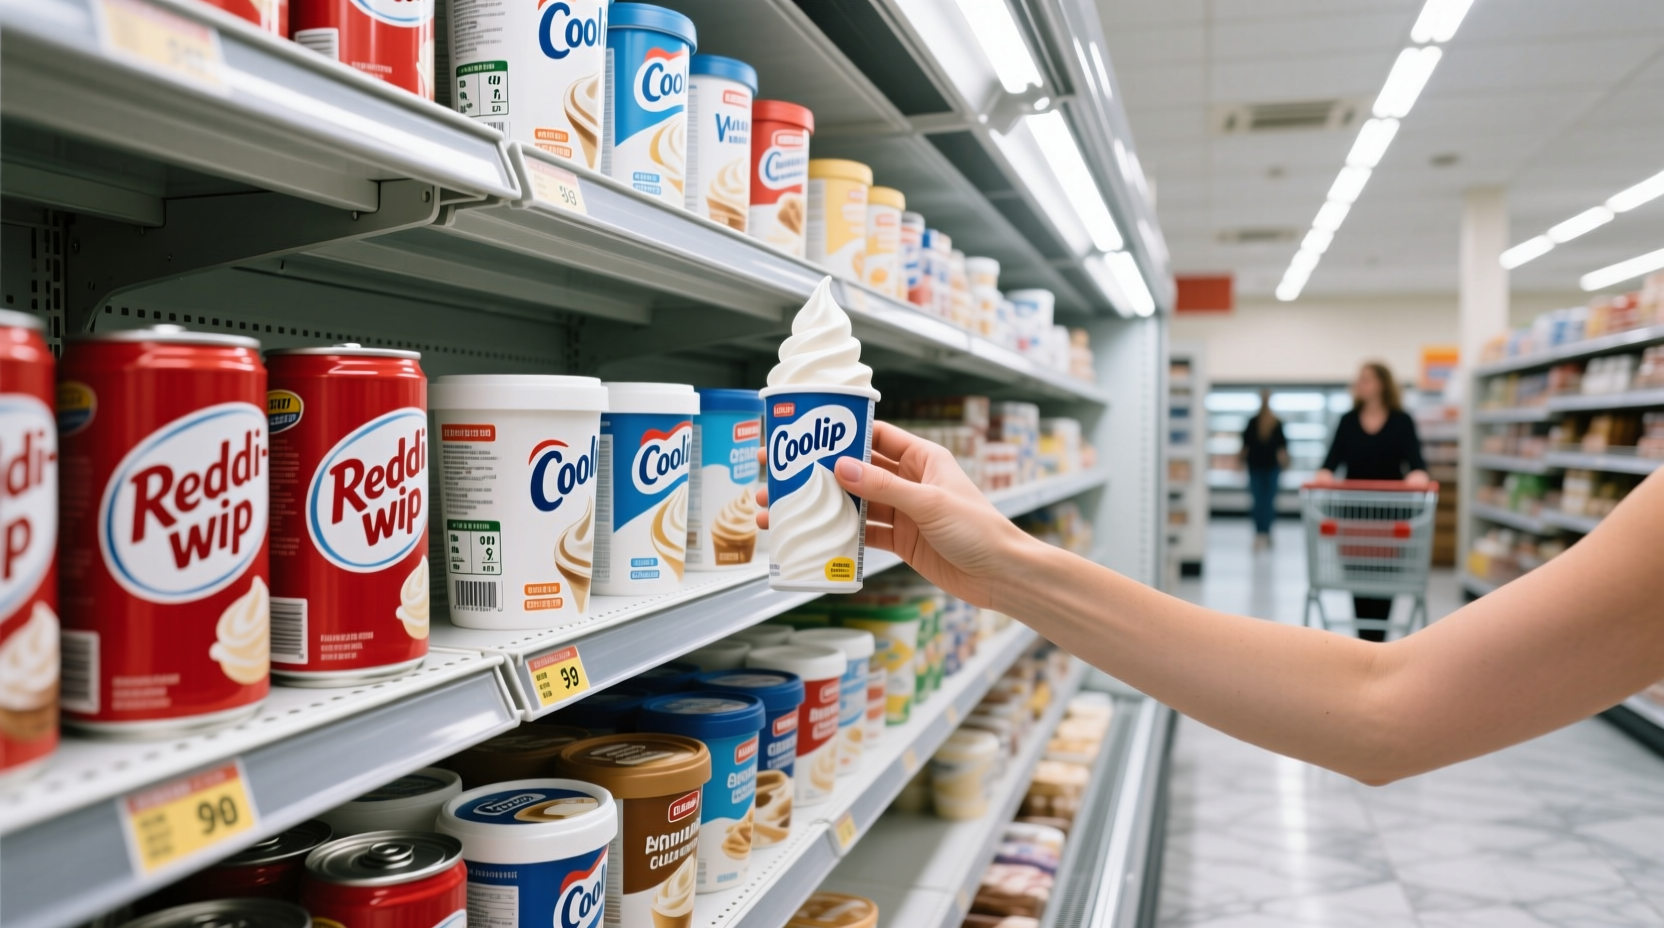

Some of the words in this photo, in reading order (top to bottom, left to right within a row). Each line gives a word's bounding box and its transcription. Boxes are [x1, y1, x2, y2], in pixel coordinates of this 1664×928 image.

[0, 428, 57, 497] di-
[329, 427, 426, 526] Reddi
[773, 416, 846, 472] Coolip
[130, 429, 268, 544] Reddi-
[361, 486, 422, 548] wip
[168, 499, 253, 570] wip
